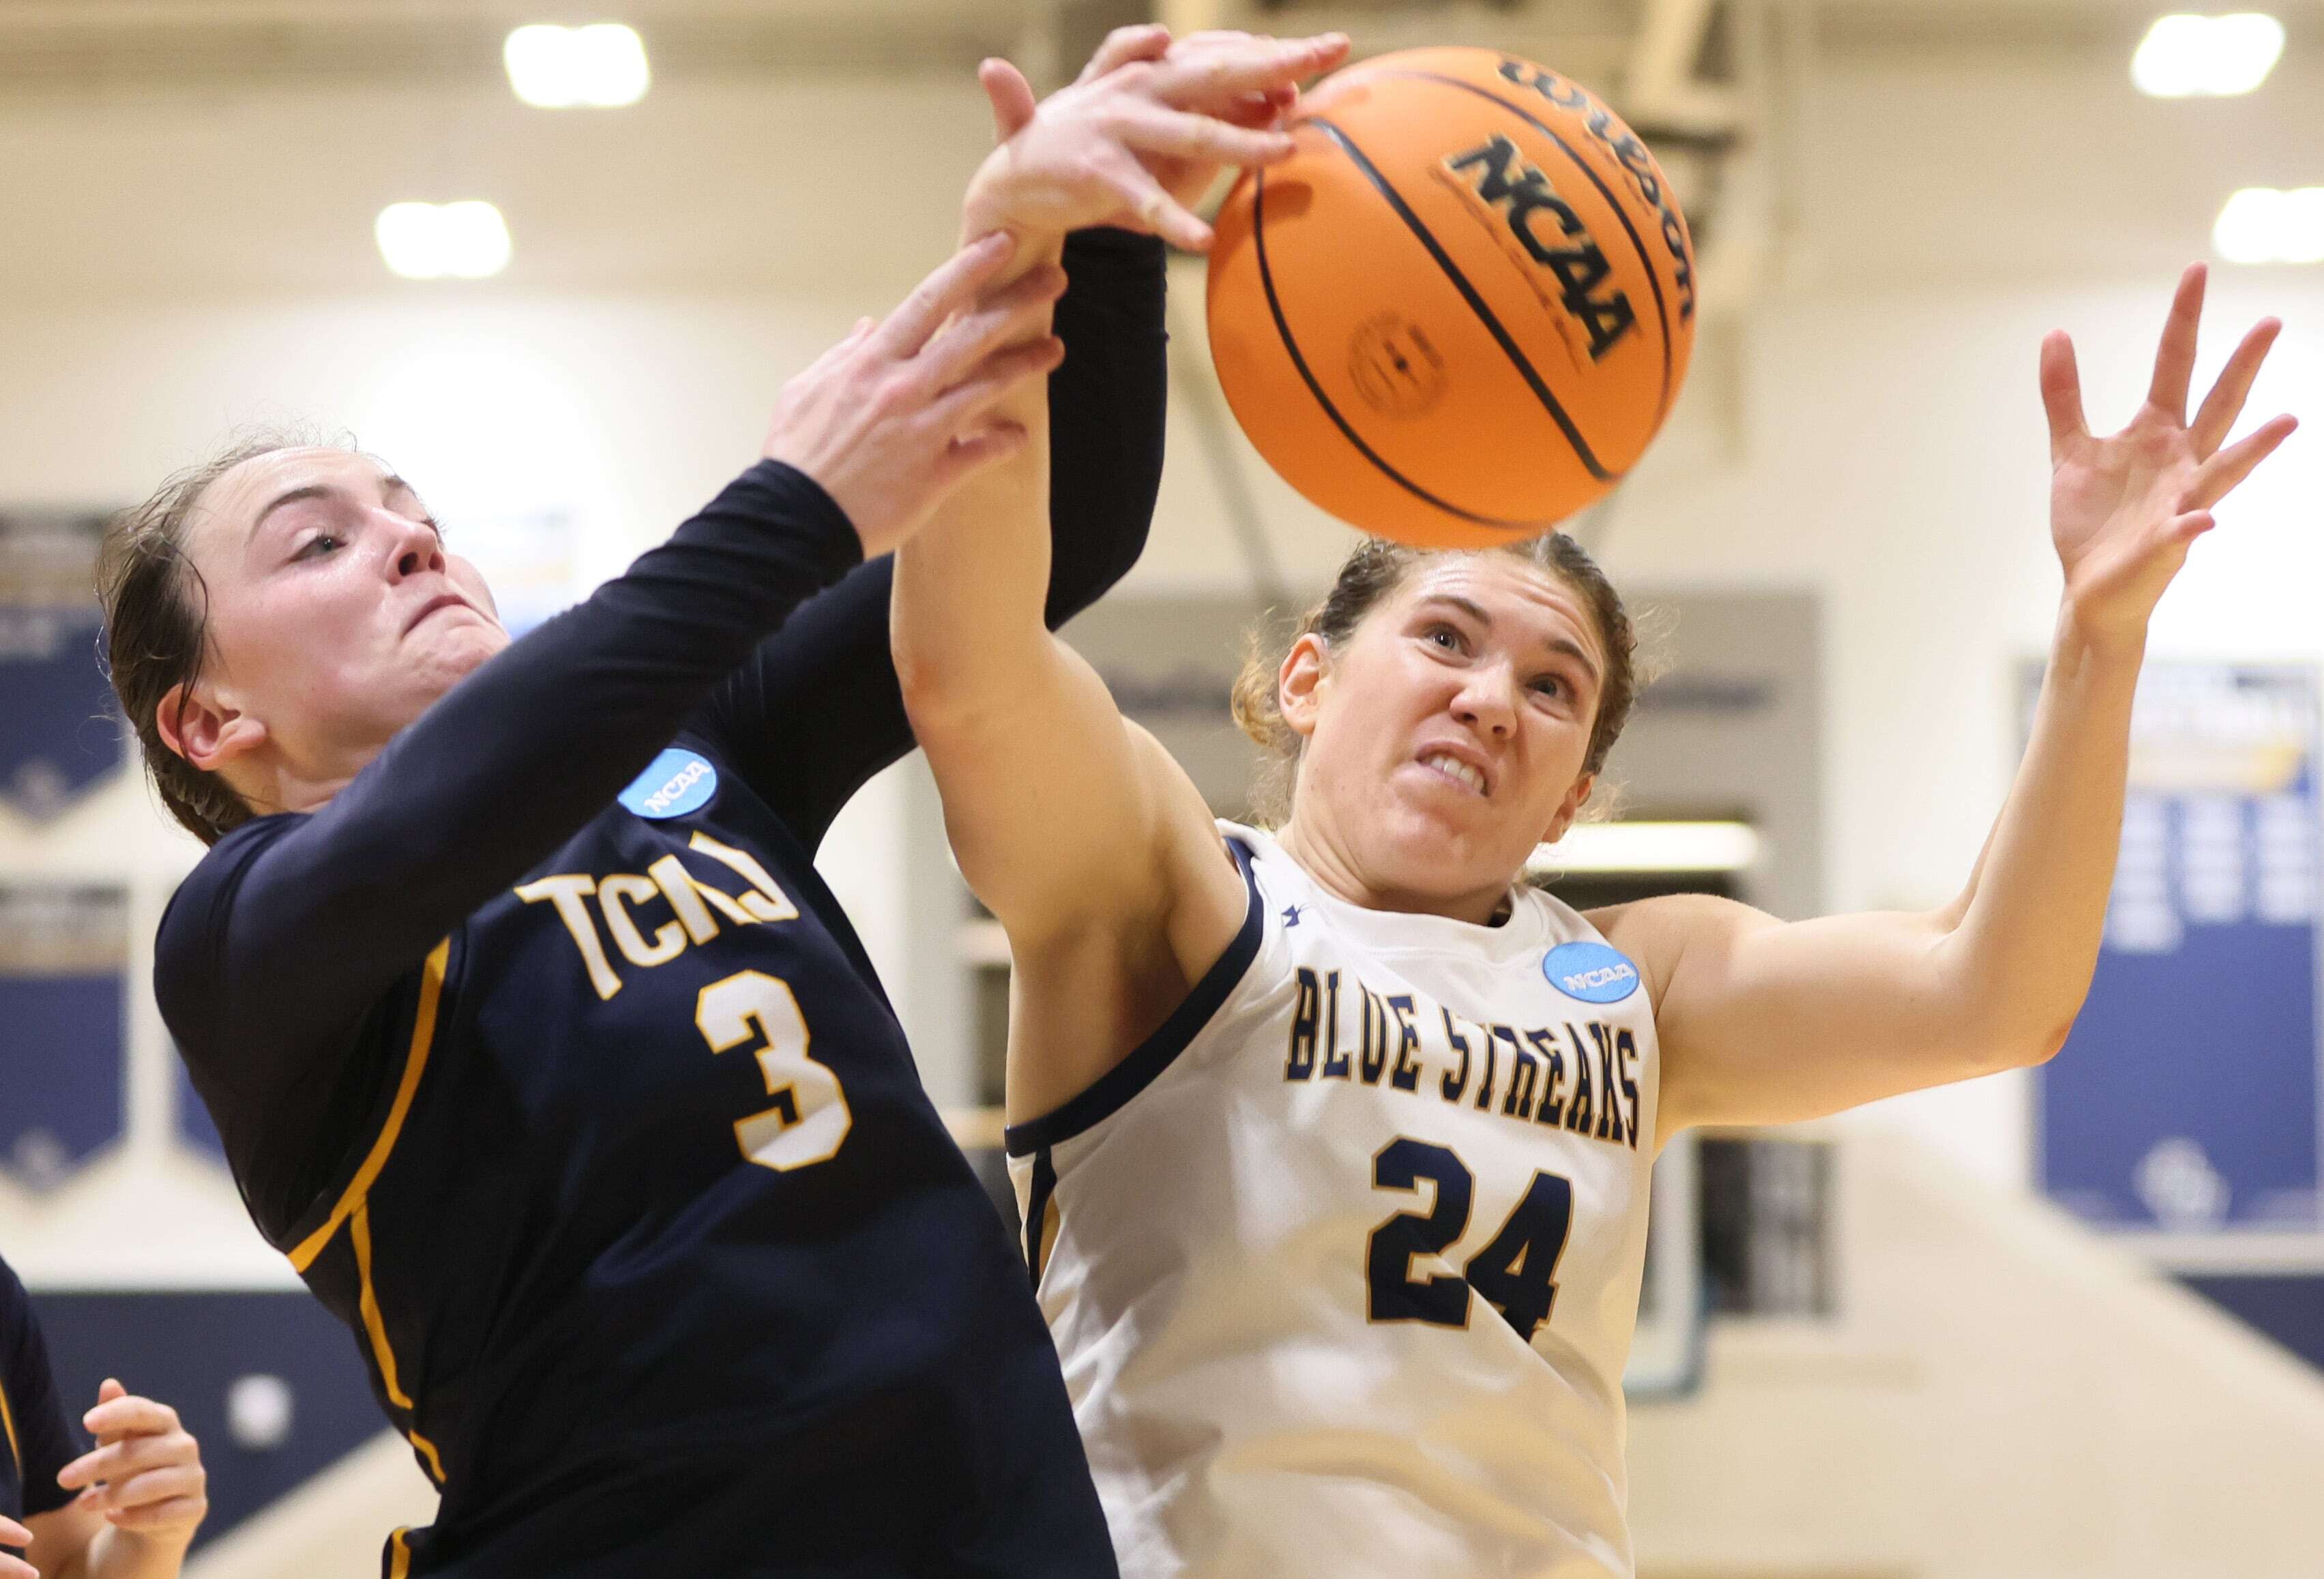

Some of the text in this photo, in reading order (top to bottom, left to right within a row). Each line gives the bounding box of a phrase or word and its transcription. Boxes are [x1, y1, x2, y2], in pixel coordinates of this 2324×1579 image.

[1442, 133, 1641, 365] NCAA
[643, 760, 711, 814] NCAA
[694, 969, 853, 1172] 3
[1283, 965, 1638, 1153] BLUE STREAKS
[1563, 962, 1637, 992] NCAA
[1366, 1133, 1574, 1344] 24
